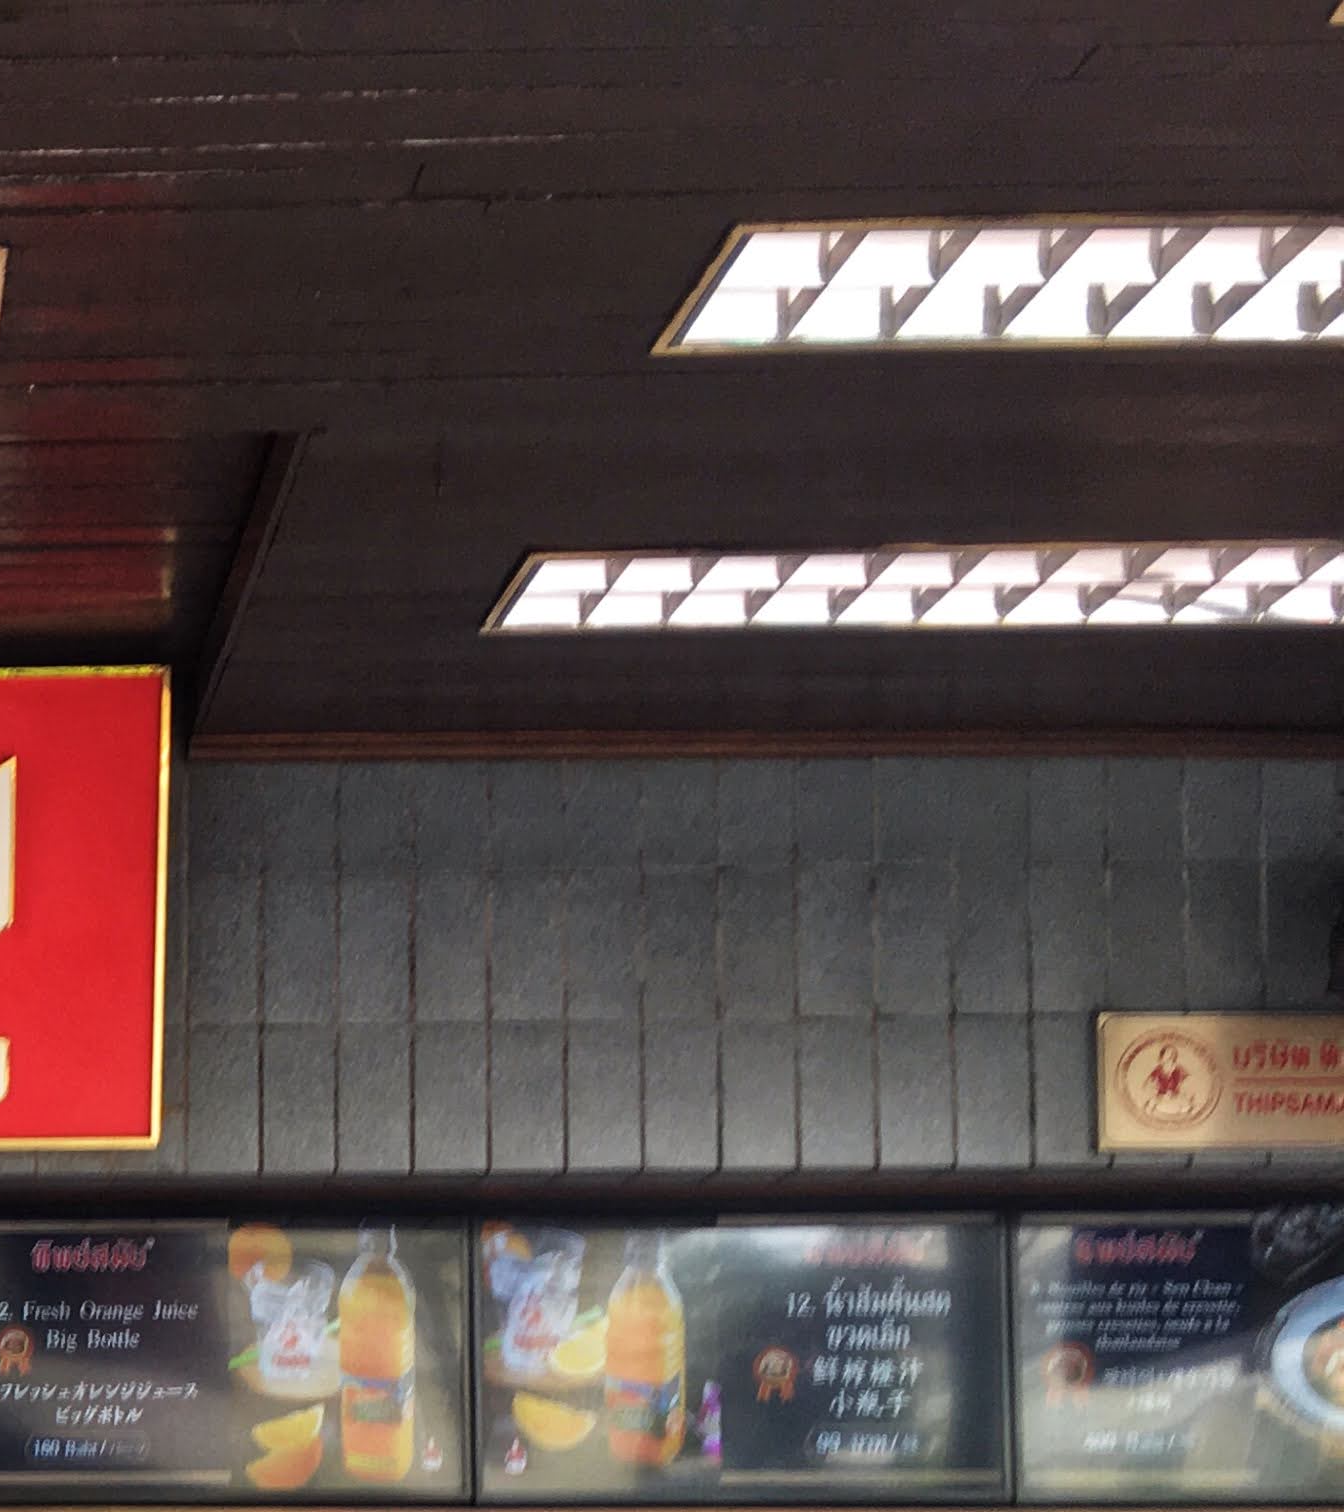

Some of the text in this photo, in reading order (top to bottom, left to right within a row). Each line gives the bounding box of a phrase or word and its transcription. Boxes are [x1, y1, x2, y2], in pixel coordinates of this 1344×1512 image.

[22, 1300, 71, 1322] Fresh
[79, 1300, 145, 1325] Orange
[152, 1300, 199, 1322] Juice
[46, 1328, 141, 1352] Big Bottle
